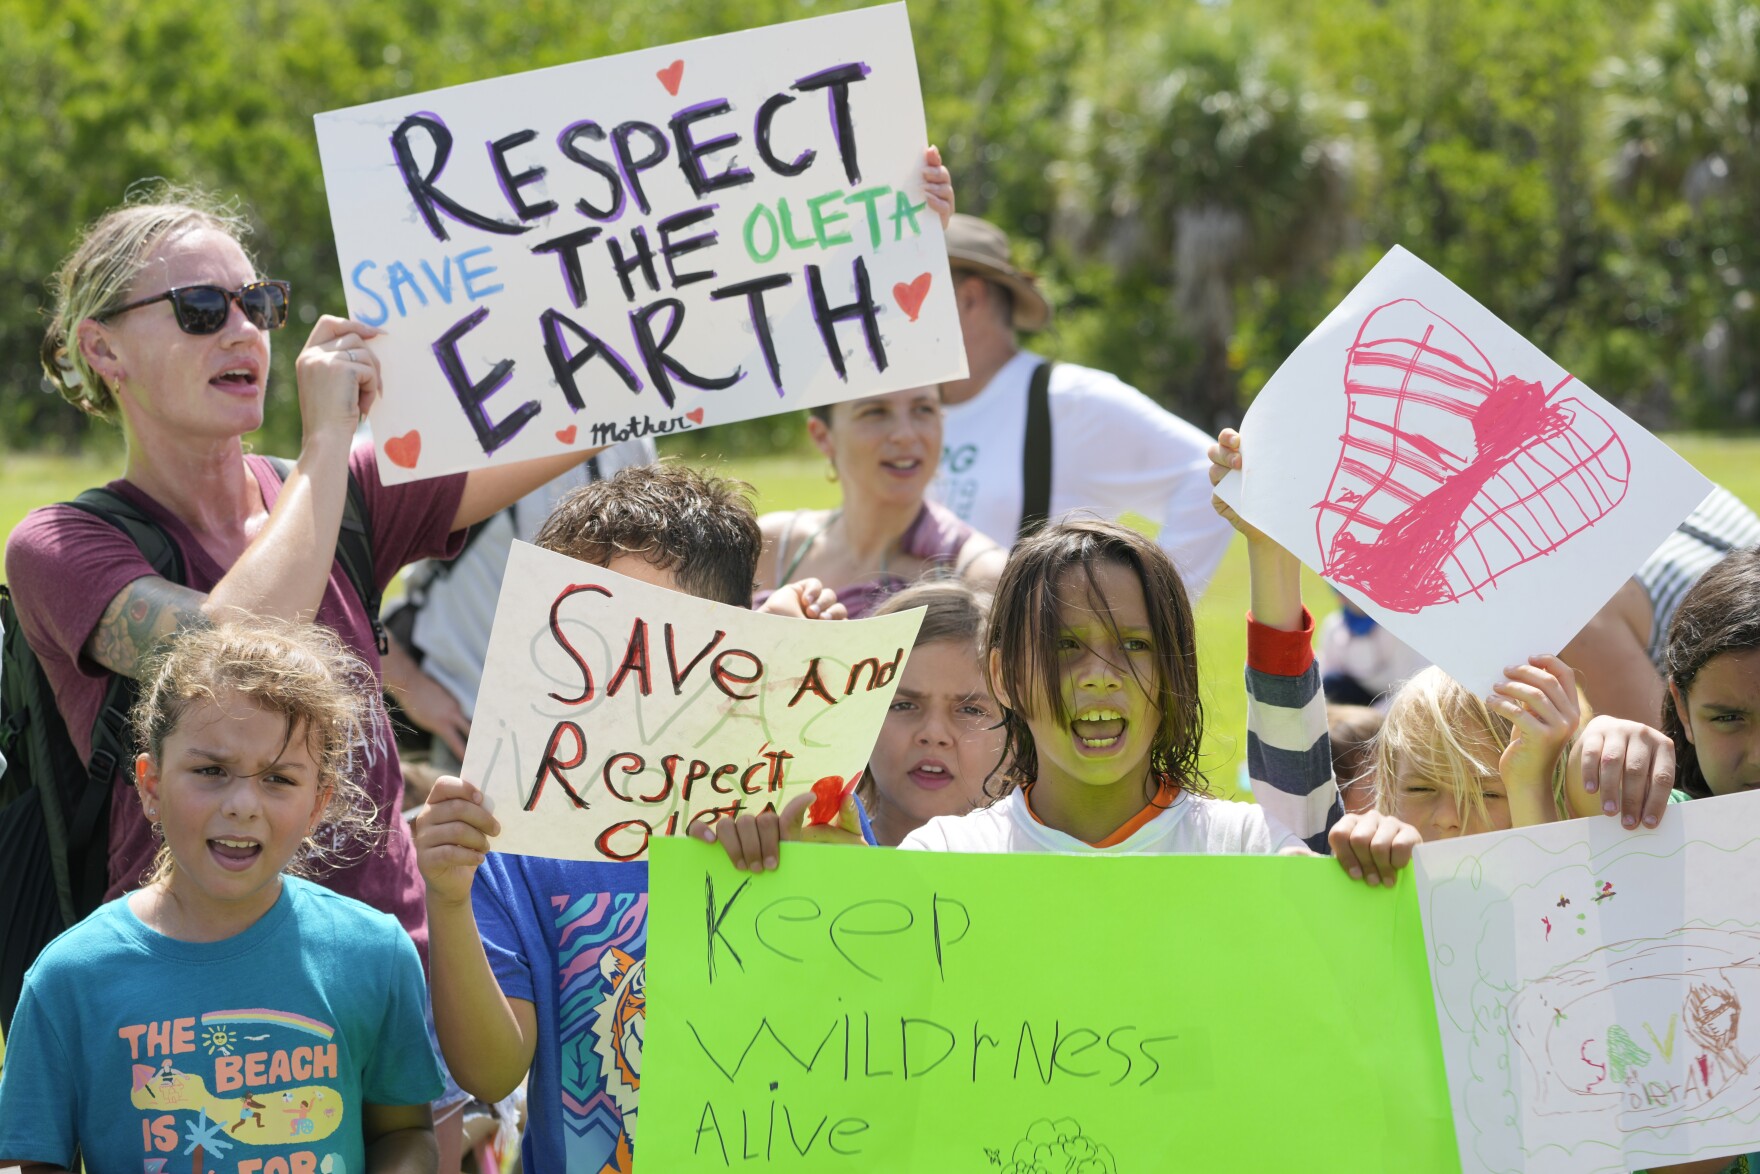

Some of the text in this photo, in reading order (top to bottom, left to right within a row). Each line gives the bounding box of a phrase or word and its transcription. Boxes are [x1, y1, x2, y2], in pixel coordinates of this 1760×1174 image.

[389, 61, 871, 243] RESPECT
[531, 203, 720, 309] THE
[742, 185, 927, 265] OLETA
[351, 245, 505, 328] SAVE
[431, 255, 890, 457] EARTH
[118, 1016, 196, 1060] THE
[213, 1043, 338, 1093] BEACH
[142, 1114, 179, 1152] IS
